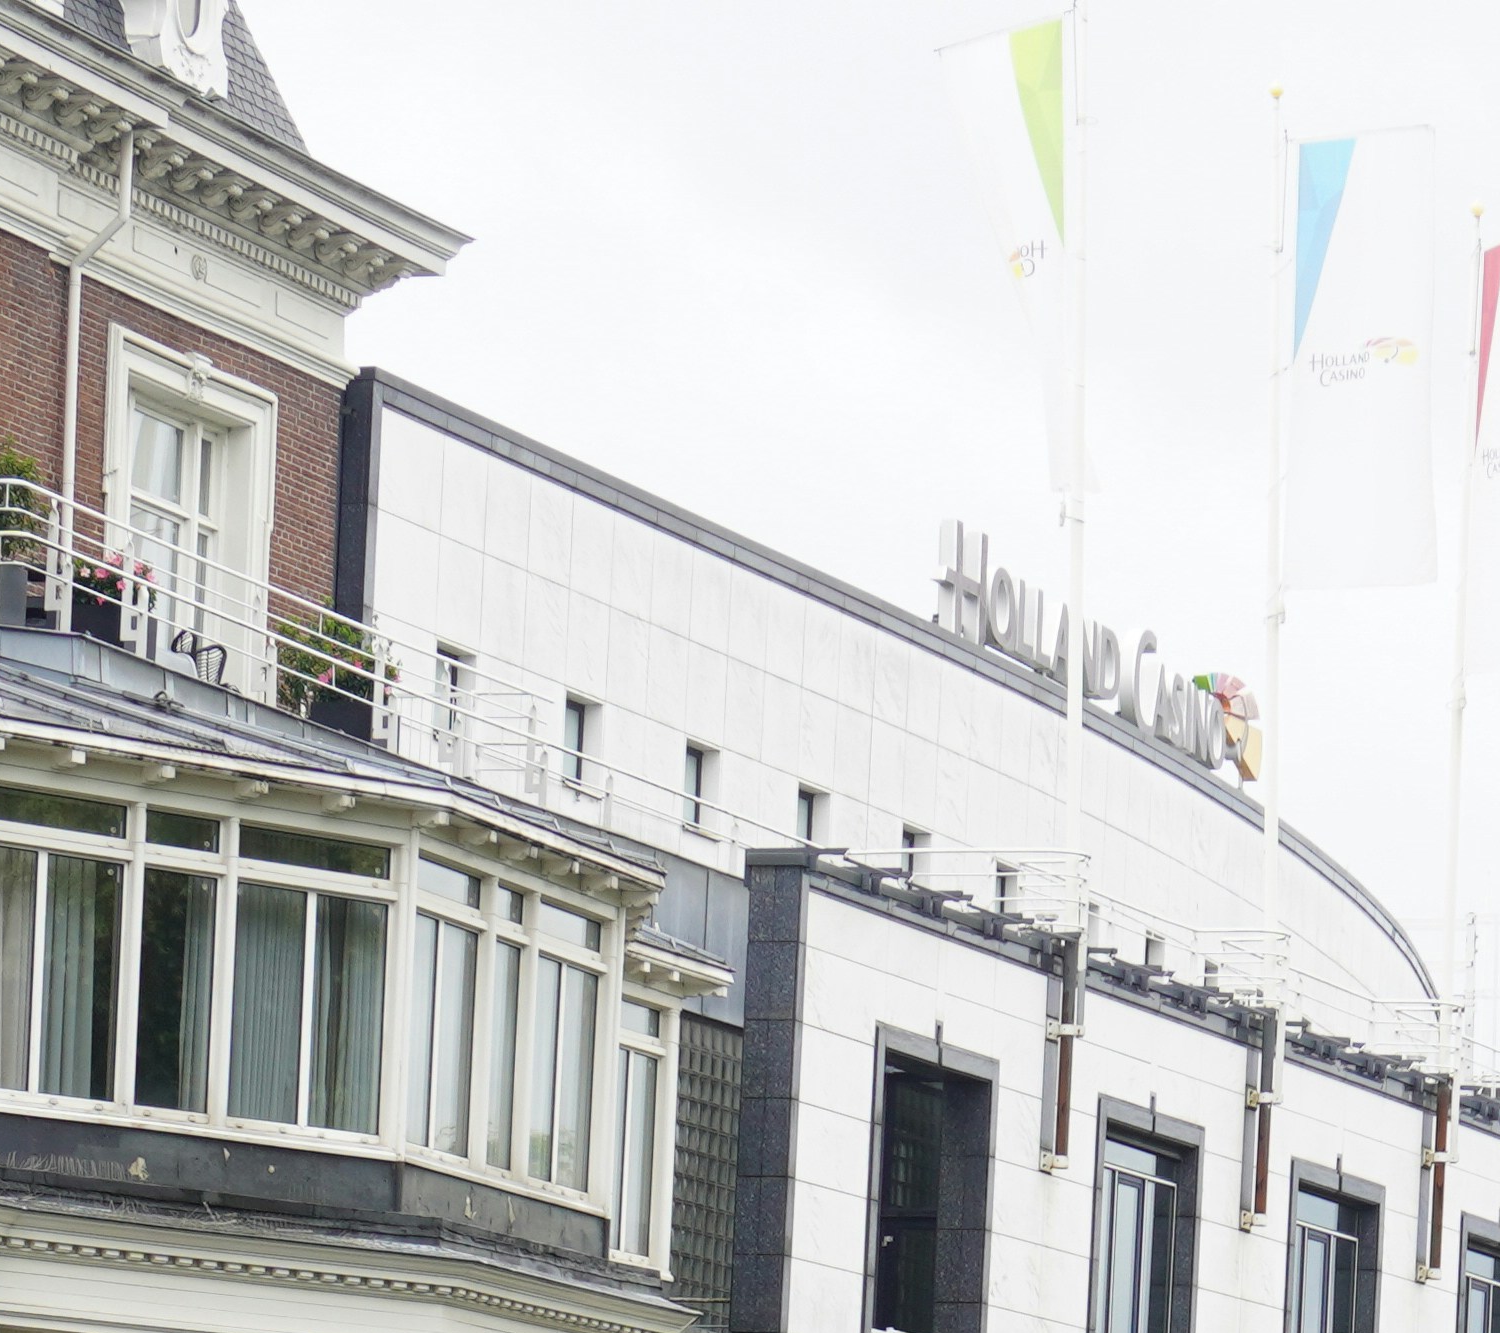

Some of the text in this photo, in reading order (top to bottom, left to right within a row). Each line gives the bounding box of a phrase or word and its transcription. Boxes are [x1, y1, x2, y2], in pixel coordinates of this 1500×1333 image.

[1309, 352, 1370, 373] HOLLAND
[1319, 367, 1366, 387] CASINO
[1117, 628, 1226, 771] CASINO
